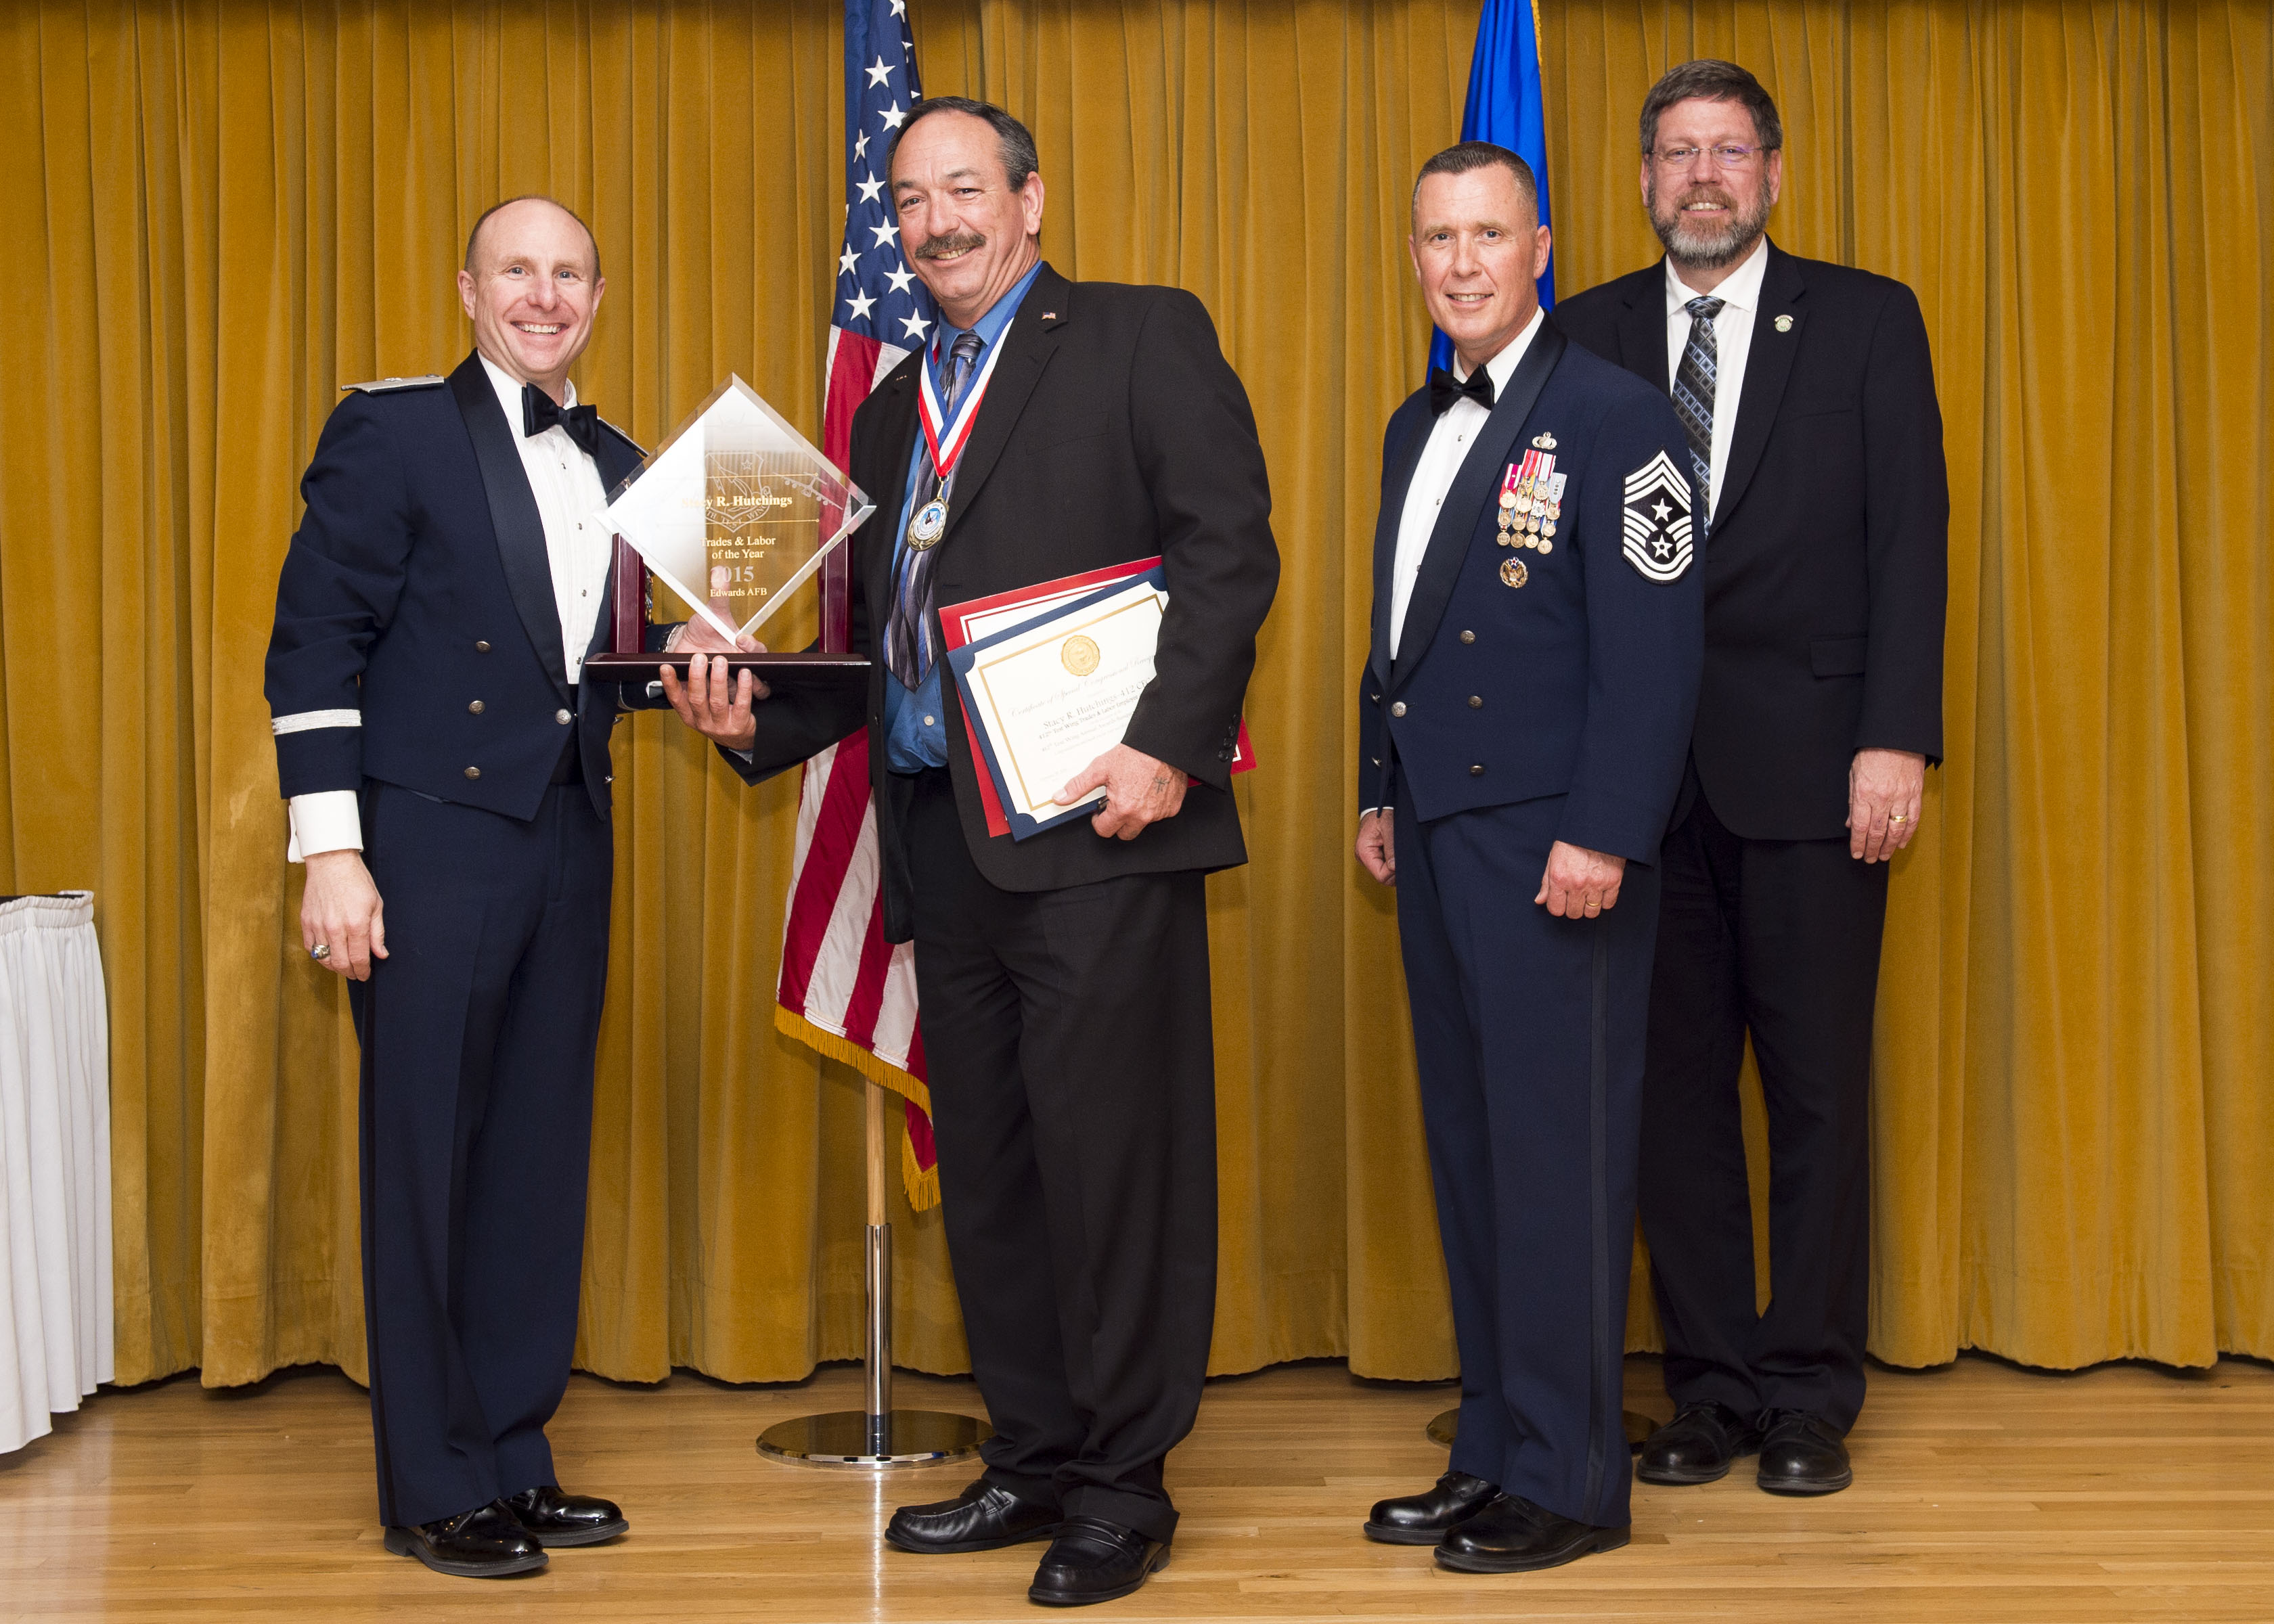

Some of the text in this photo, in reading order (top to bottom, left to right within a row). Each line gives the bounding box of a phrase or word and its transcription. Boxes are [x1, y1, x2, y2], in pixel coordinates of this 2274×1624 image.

[717, 496, 730, 506] R.
[733, 495, 793, 508] Hutchings
[699, 536, 776, 547] Trades & Labor
[711, 549, 765, 559] of the Year
[710, 587, 767, 597] Edwards AFB
[1043, 716, 1066, 729] Stacy
